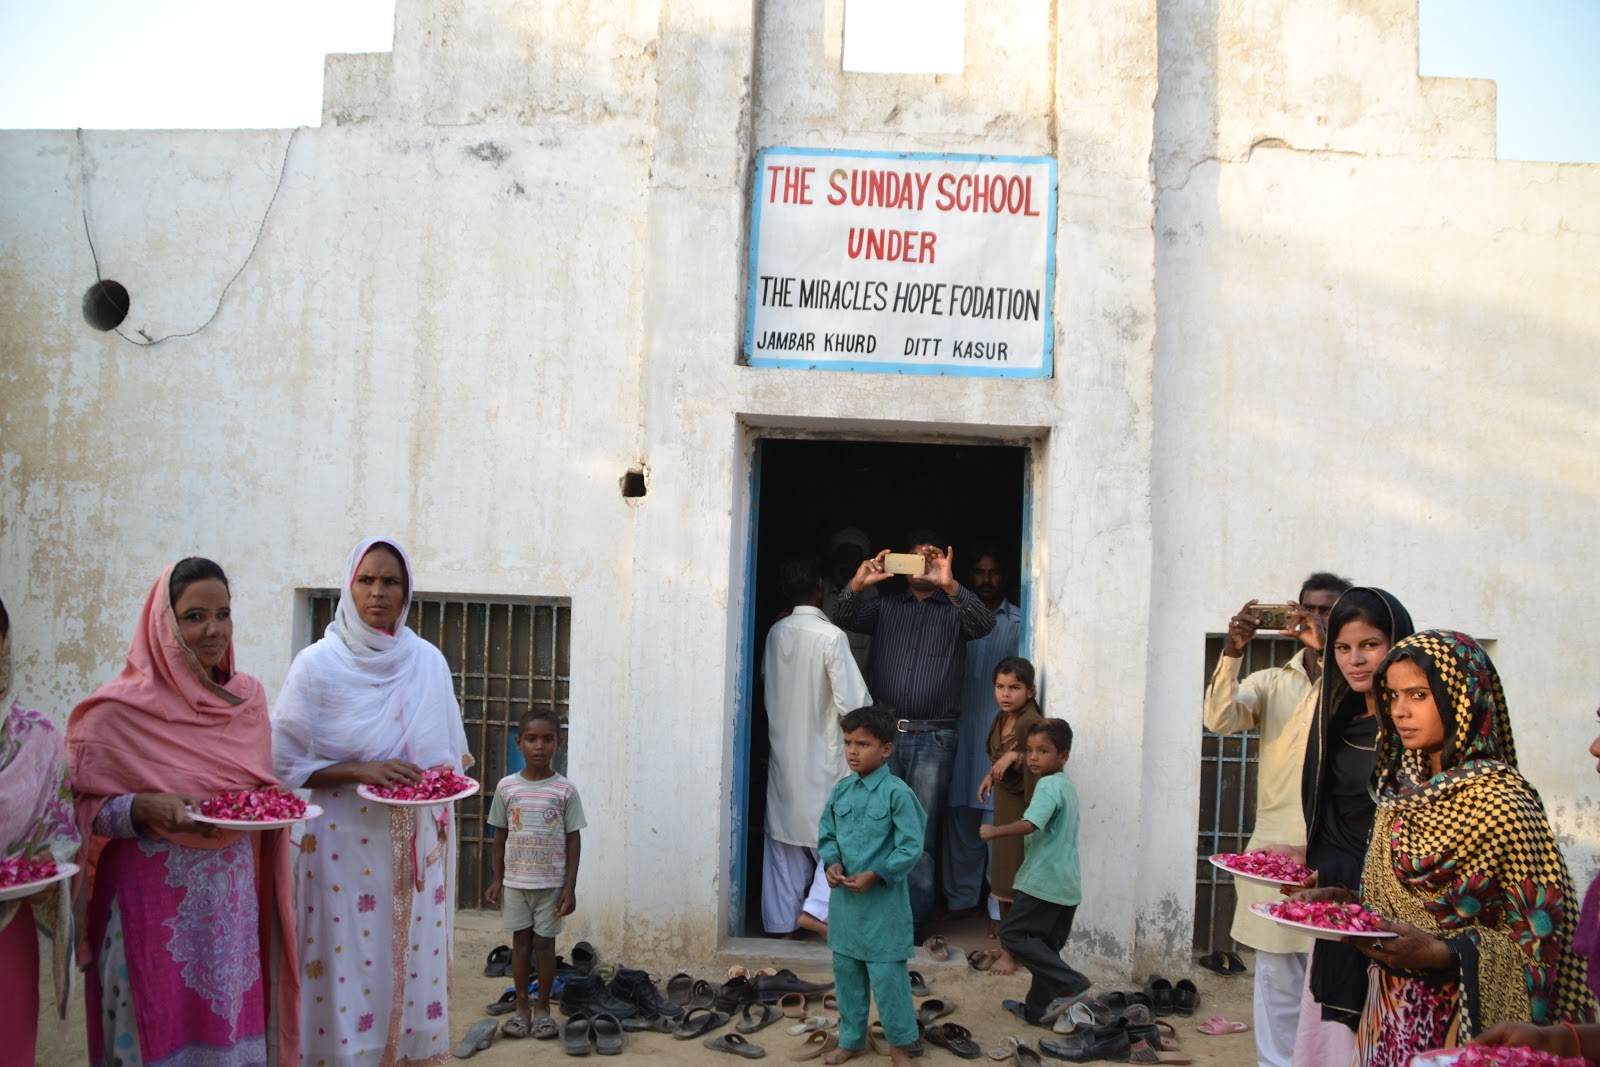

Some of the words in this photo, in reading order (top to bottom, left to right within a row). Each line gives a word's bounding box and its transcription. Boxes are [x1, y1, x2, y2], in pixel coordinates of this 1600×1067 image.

[767, 166, 815, 205] THE
[827, 168, 932, 211] SUNDAY
[935, 173, 1040, 217] SCHOOL
[847, 227, 937, 264] UNDER
[760, 276, 796, 307] THE
[799, 279, 888, 312] MIRACLES
[892, 282, 947, 316] HOPE
[949, 285, 1040, 321] FODATION
[757, 331, 815, 352] JAMBAR
[824, 333, 876, 354] KHURD
[904, 337, 943, 357] DITT
[952, 341, 1008, 361] KASUR
